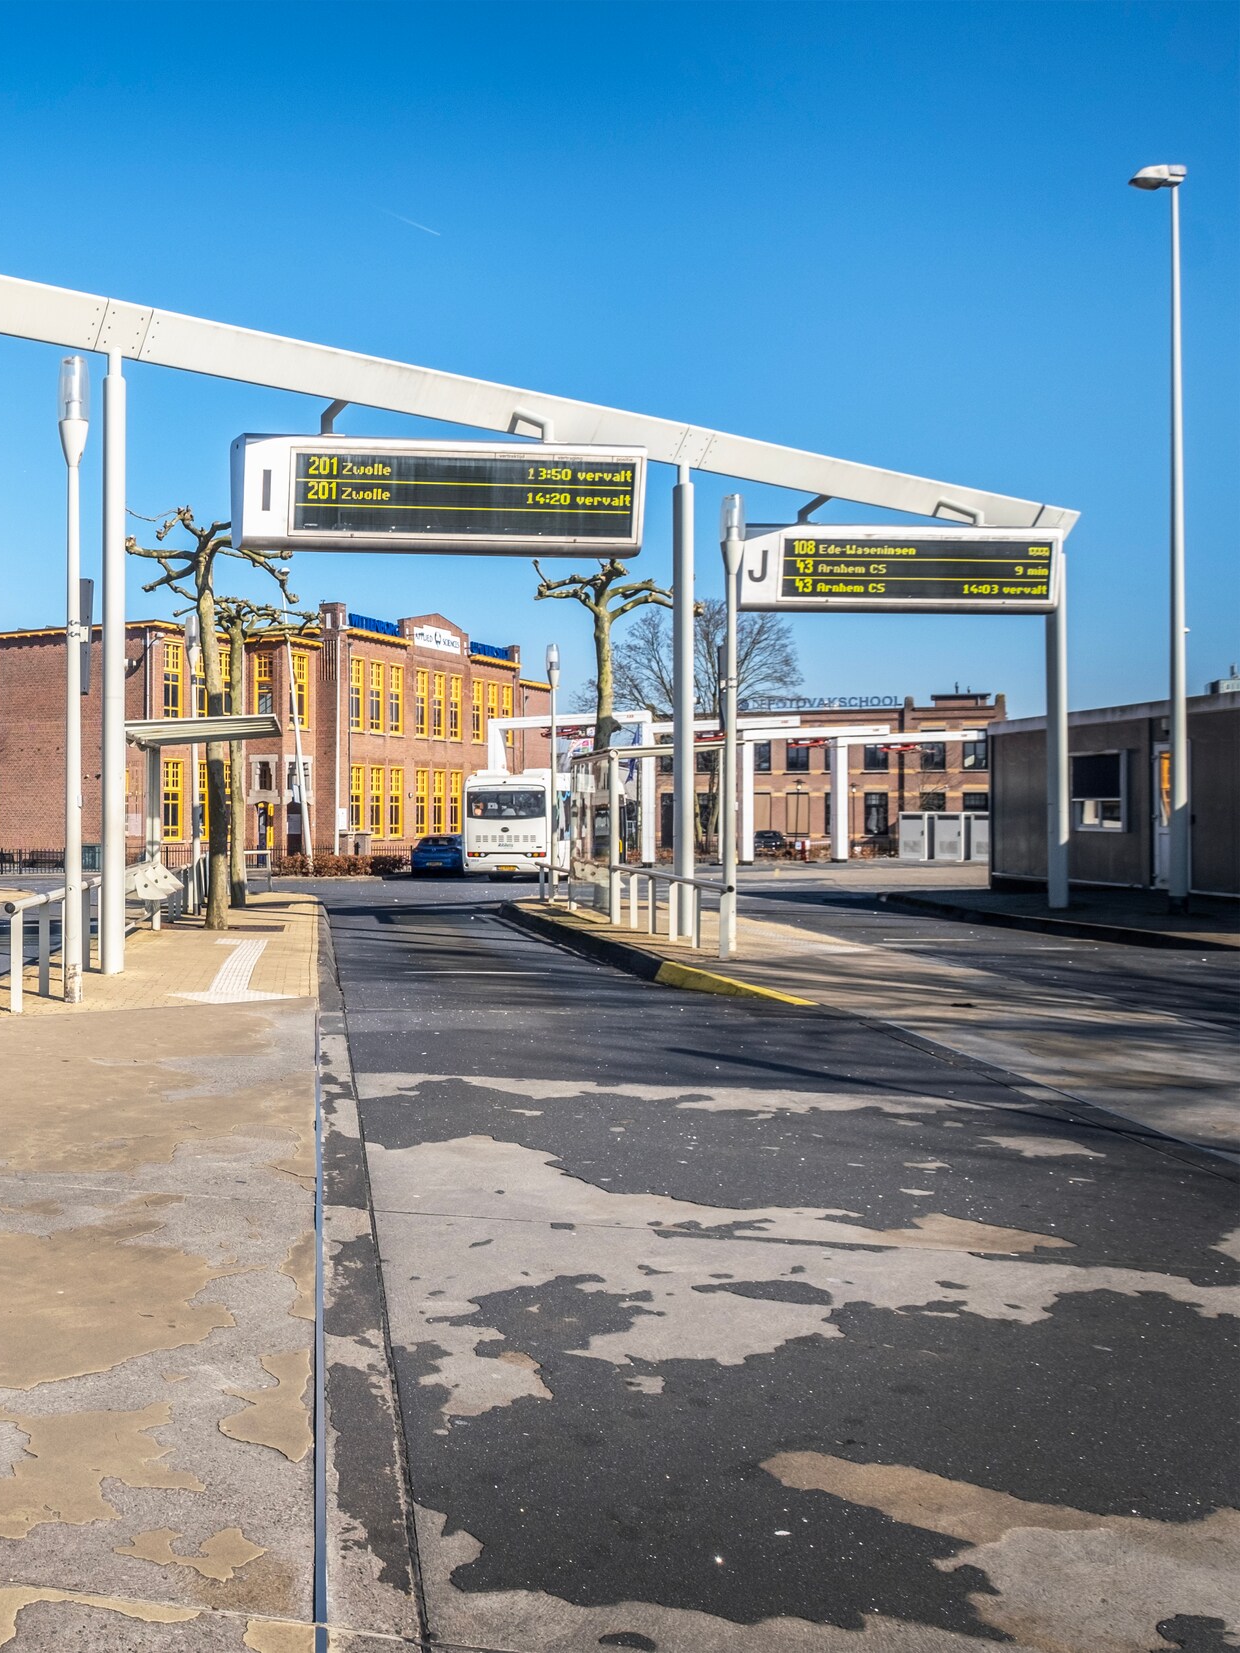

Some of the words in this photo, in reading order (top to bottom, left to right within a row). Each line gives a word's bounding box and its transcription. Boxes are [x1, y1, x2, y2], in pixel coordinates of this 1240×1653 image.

[308, 455, 339, 476] 201
[342, 462, 392, 477] Zwolle
[527, 467, 572, 482] 13:50
[576, 470, 633, 483] vervalt
[307, 481, 337, 500] 201
[341, 486, 391, 501] Zwolle
[526, 491, 571, 506] 14:20
[575, 493, 632, 507] vervalt
[793, 540, 816, 555] 108
[818, 544, 917, 556] Ede-Wageningen
[747, 549, 769, 583] J
[796, 559, 814, 574] 43
[817, 563, 865, 574] Arnhem
[869, 563, 887, 574] CS
[1014, 565, 1024, 576] 9
[1026, 566, 1049, 576] min
[794, 578, 813, 593] 43
[816, 582, 865, 593] Arnhem
[867, 582, 886, 593] CS
[962, 583, 1000, 595] 14:03
[1001, 585, 1048, 595] vervalt
